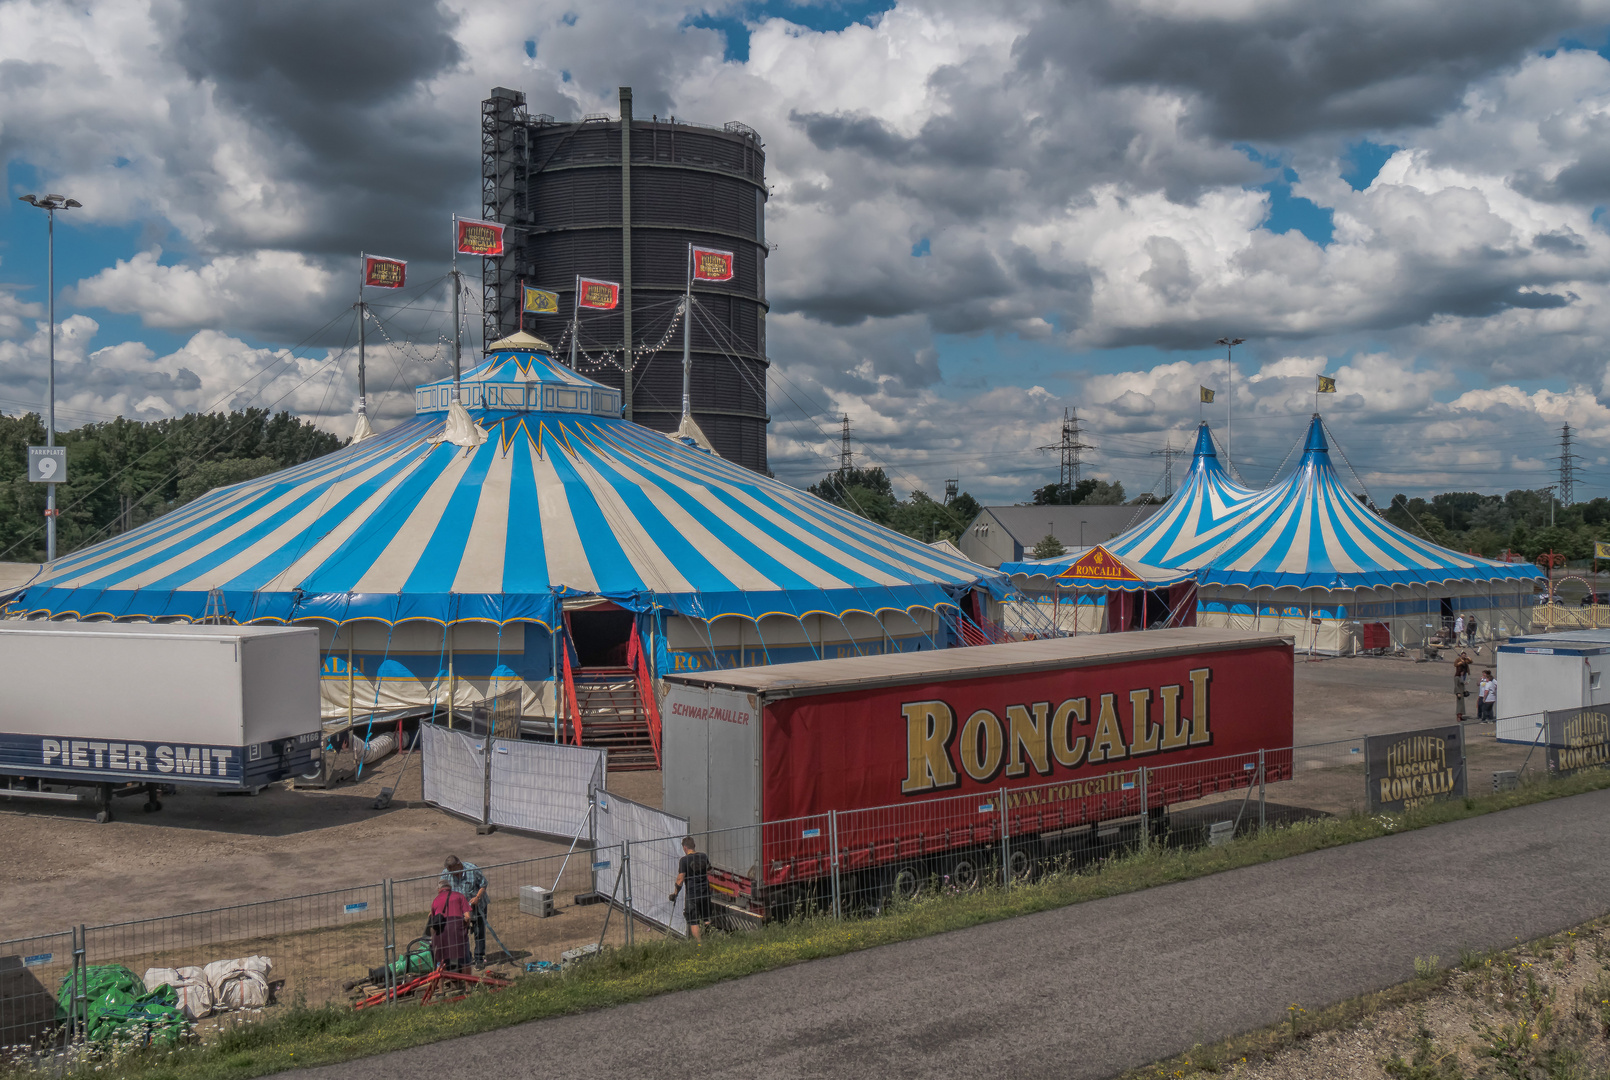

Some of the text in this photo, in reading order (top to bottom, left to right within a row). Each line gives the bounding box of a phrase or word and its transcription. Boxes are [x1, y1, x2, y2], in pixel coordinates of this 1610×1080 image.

[38, 457, 57, 479] 9
[1076, 565, 1122, 577] RONCALLI
[671, 702, 750, 726] SCHWARZMÜLLER
[901, 667, 1212, 796] RONCALLI
[42, 739, 232, 776] PIETER SMIT
[986, 769, 1154, 812] www.roncallide
[1380, 767, 1454, 803] RONCALLI
